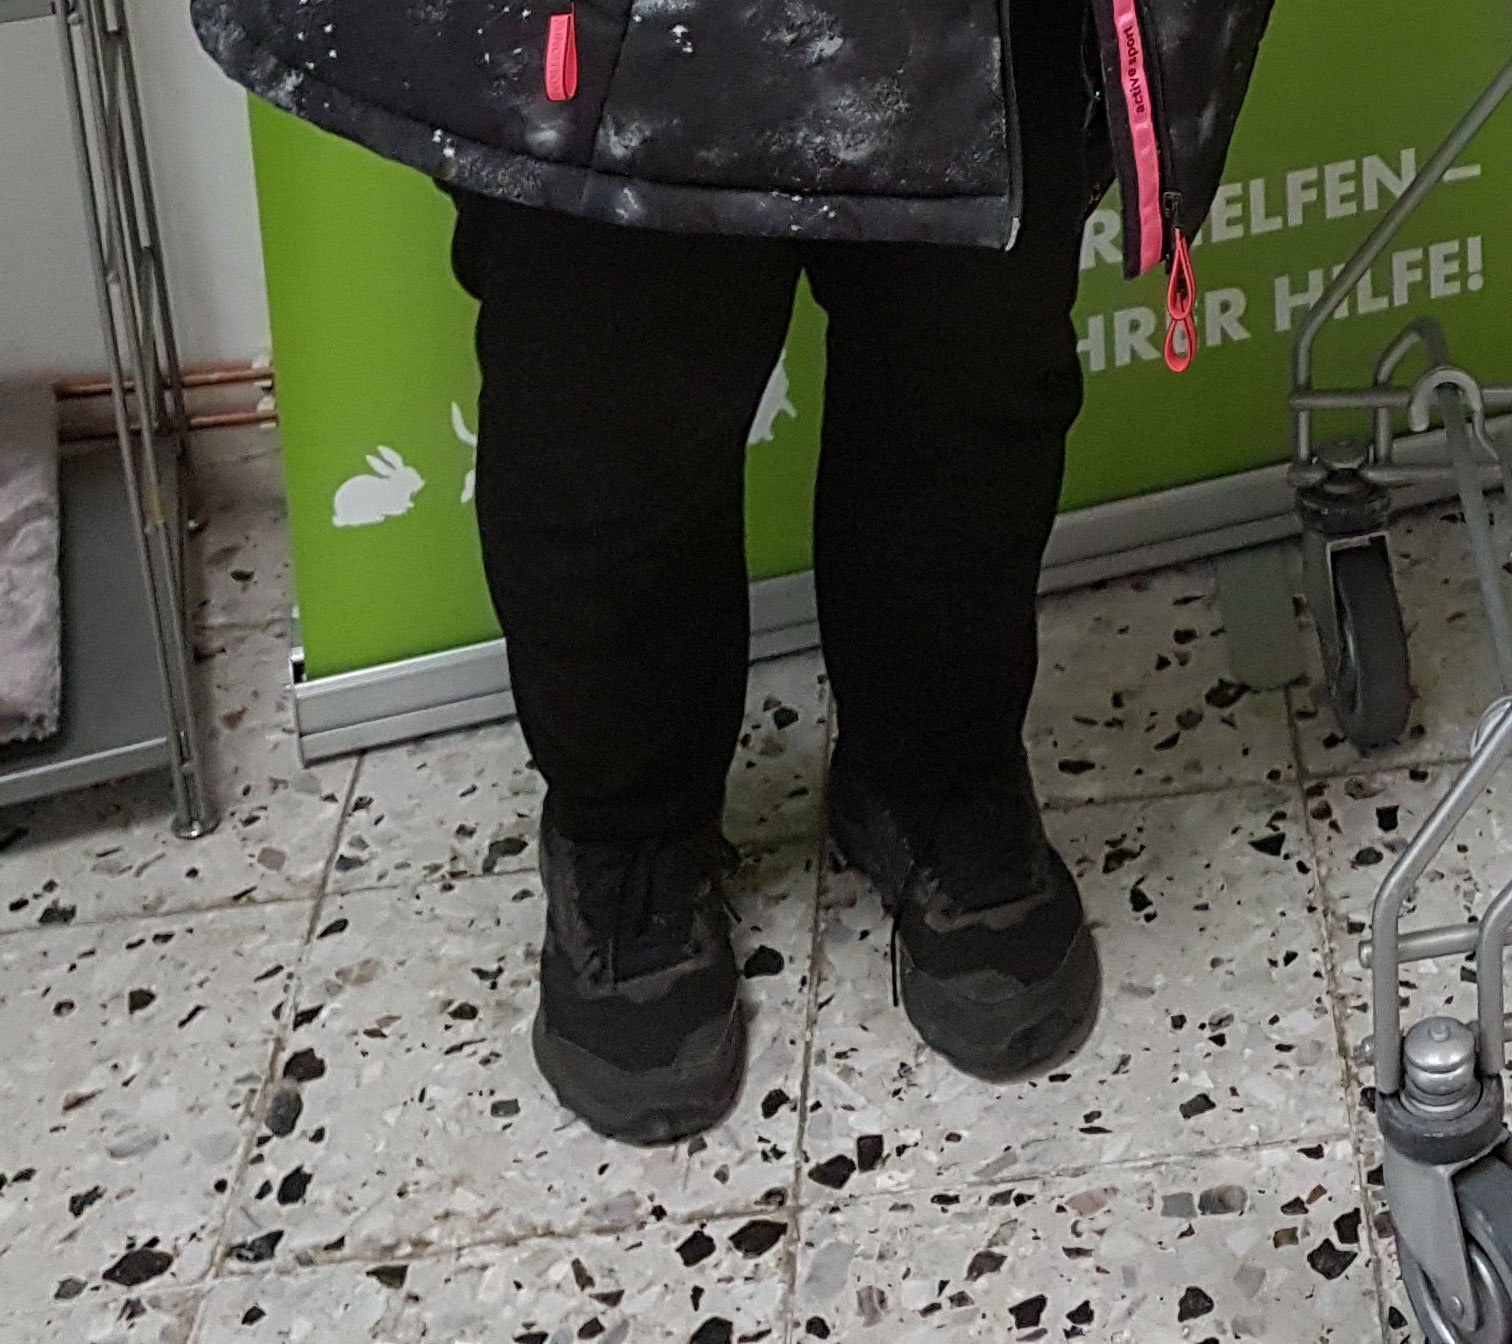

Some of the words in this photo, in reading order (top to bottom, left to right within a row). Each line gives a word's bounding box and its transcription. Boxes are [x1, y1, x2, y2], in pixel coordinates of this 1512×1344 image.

[1123, 26, 1137, 66] sport
[1129, 67, 1145, 113] active
[1191, 148, 1417, 246] ELFEN
